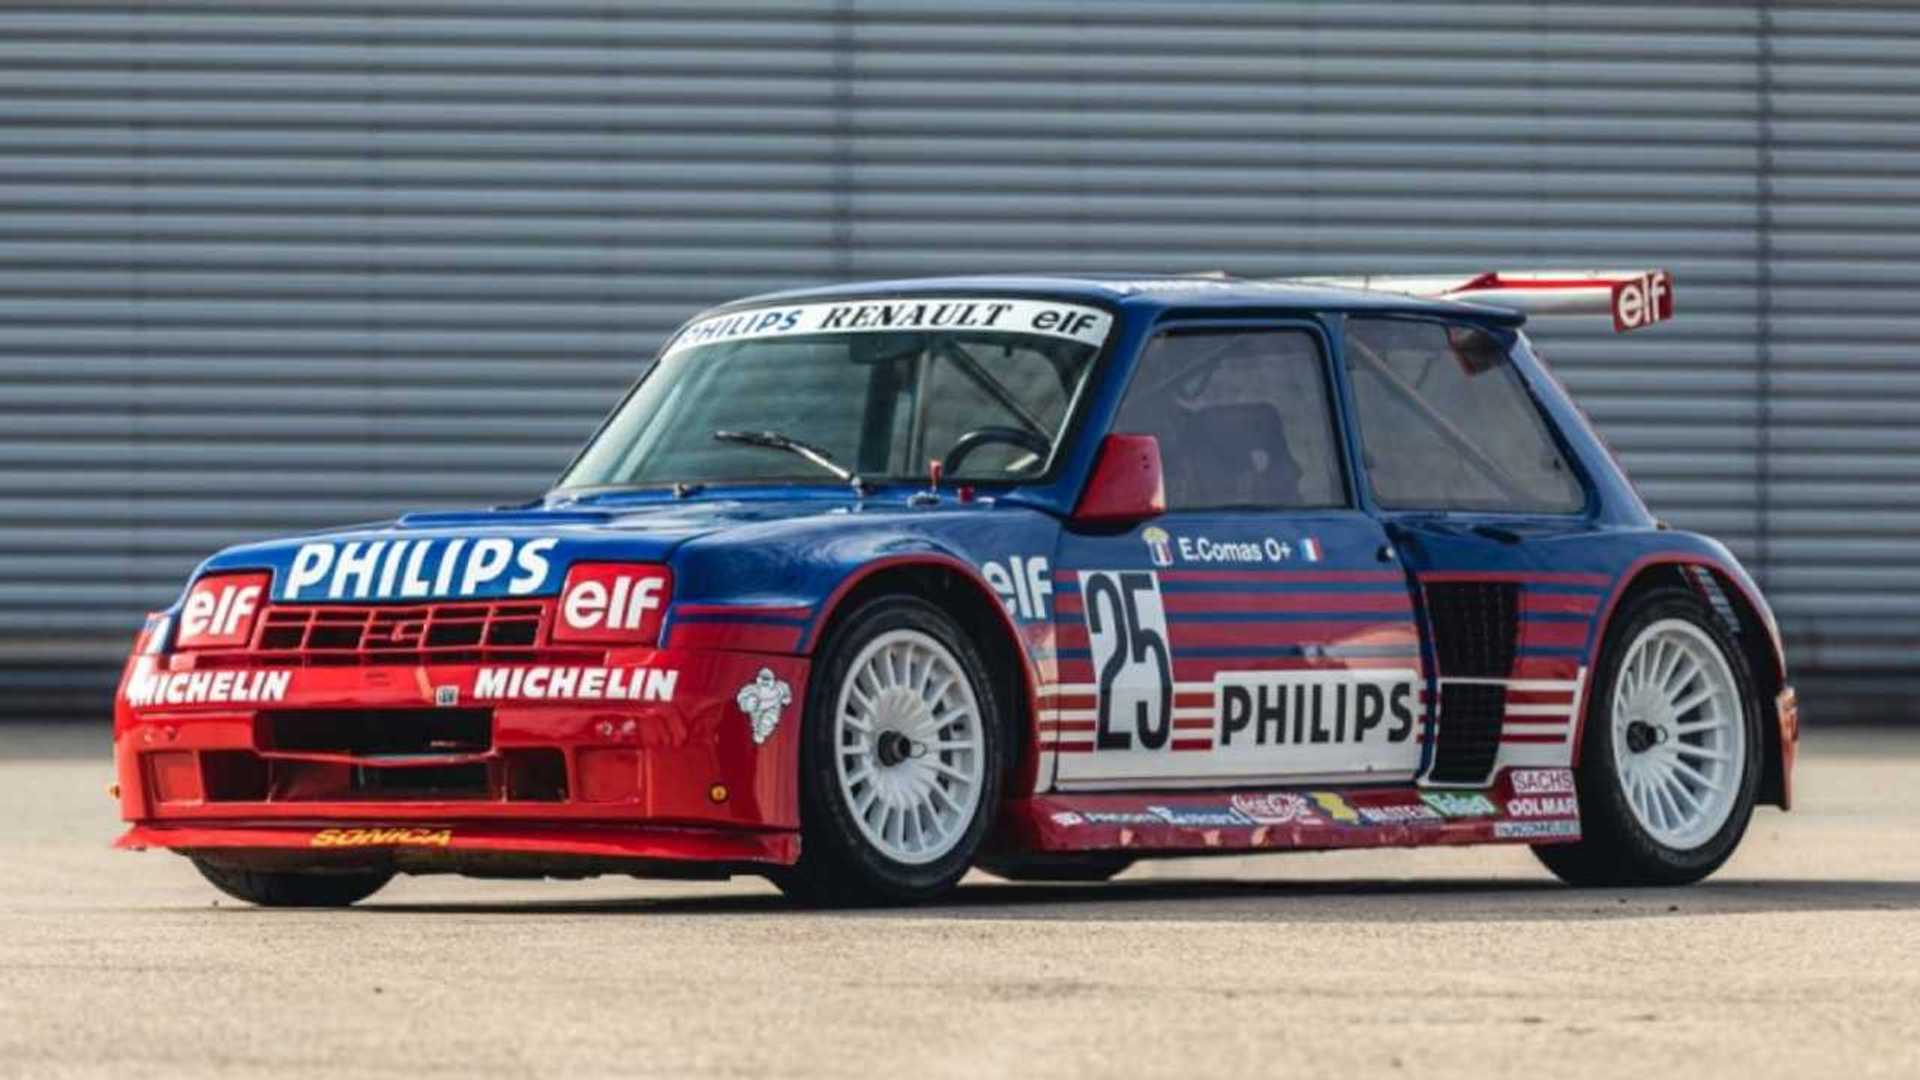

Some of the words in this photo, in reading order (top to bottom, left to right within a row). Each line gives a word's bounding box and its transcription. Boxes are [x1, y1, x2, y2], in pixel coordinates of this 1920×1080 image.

[682, 309, 803, 344] PHILIPS
[820, 302, 1011, 329] RENAULT
[1031, 309, 1097, 336] elf
[1618, 272, 1665, 327] elf
[283, 537, 558, 600] PHILIPS
[1178, 537, 1262, 562] E.Comas
[178, 583, 264, 637] elf
[563, 576, 664, 630] elf
[980, 555, 1053, 618] elf
[473, 667, 678, 701] MICHELIN
[1084, 571, 1173, 750] 25
[128, 669, 292, 707] MICHELIN
[1219, 681, 1413, 746] PHILIPS
[1513, 771, 1573, 791] SACHS
[311, 828, 452, 848] SONICA
